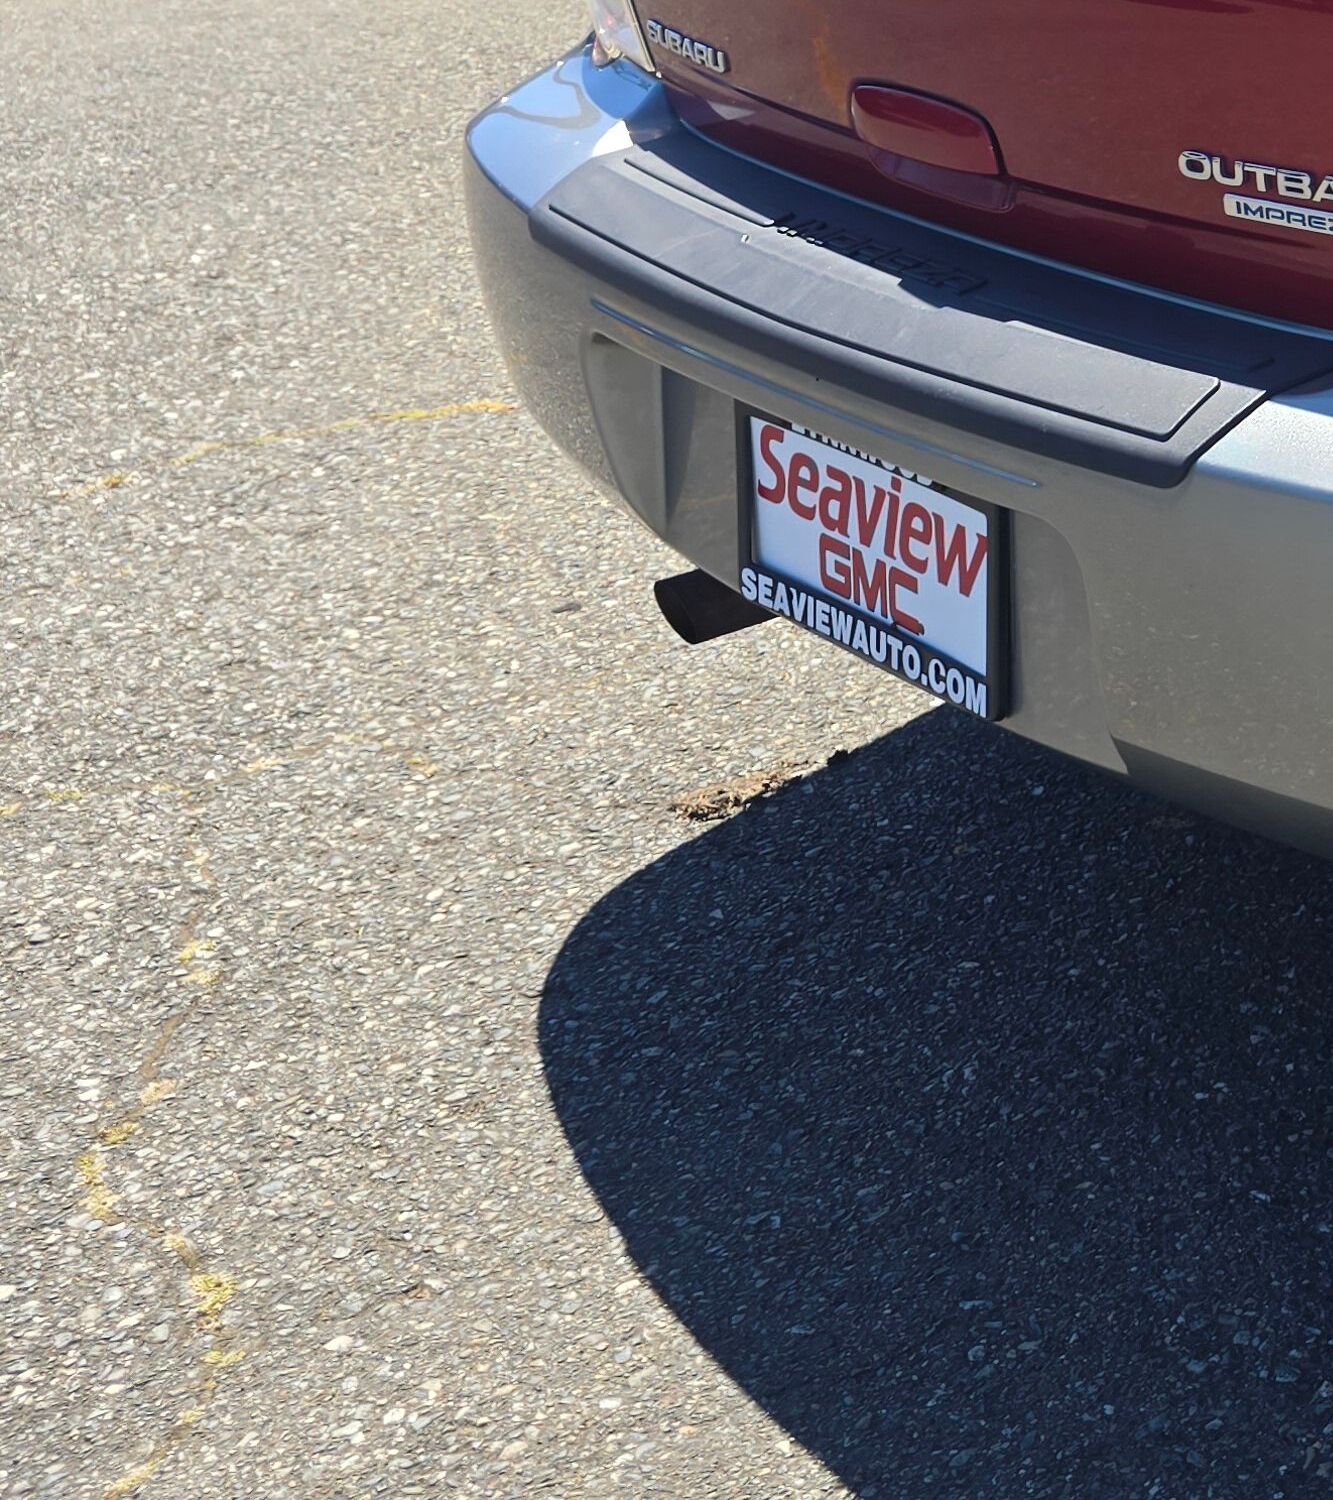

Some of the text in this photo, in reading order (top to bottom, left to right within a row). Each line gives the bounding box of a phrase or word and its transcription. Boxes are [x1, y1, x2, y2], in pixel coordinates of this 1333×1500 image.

[646, 19, 726, 74] SUBARU
[757, 423, 988, 598] Seaview
[740, 567, 988, 718] SEAVIEWAUTO.COM
[818, 531, 925, 637] GMC
